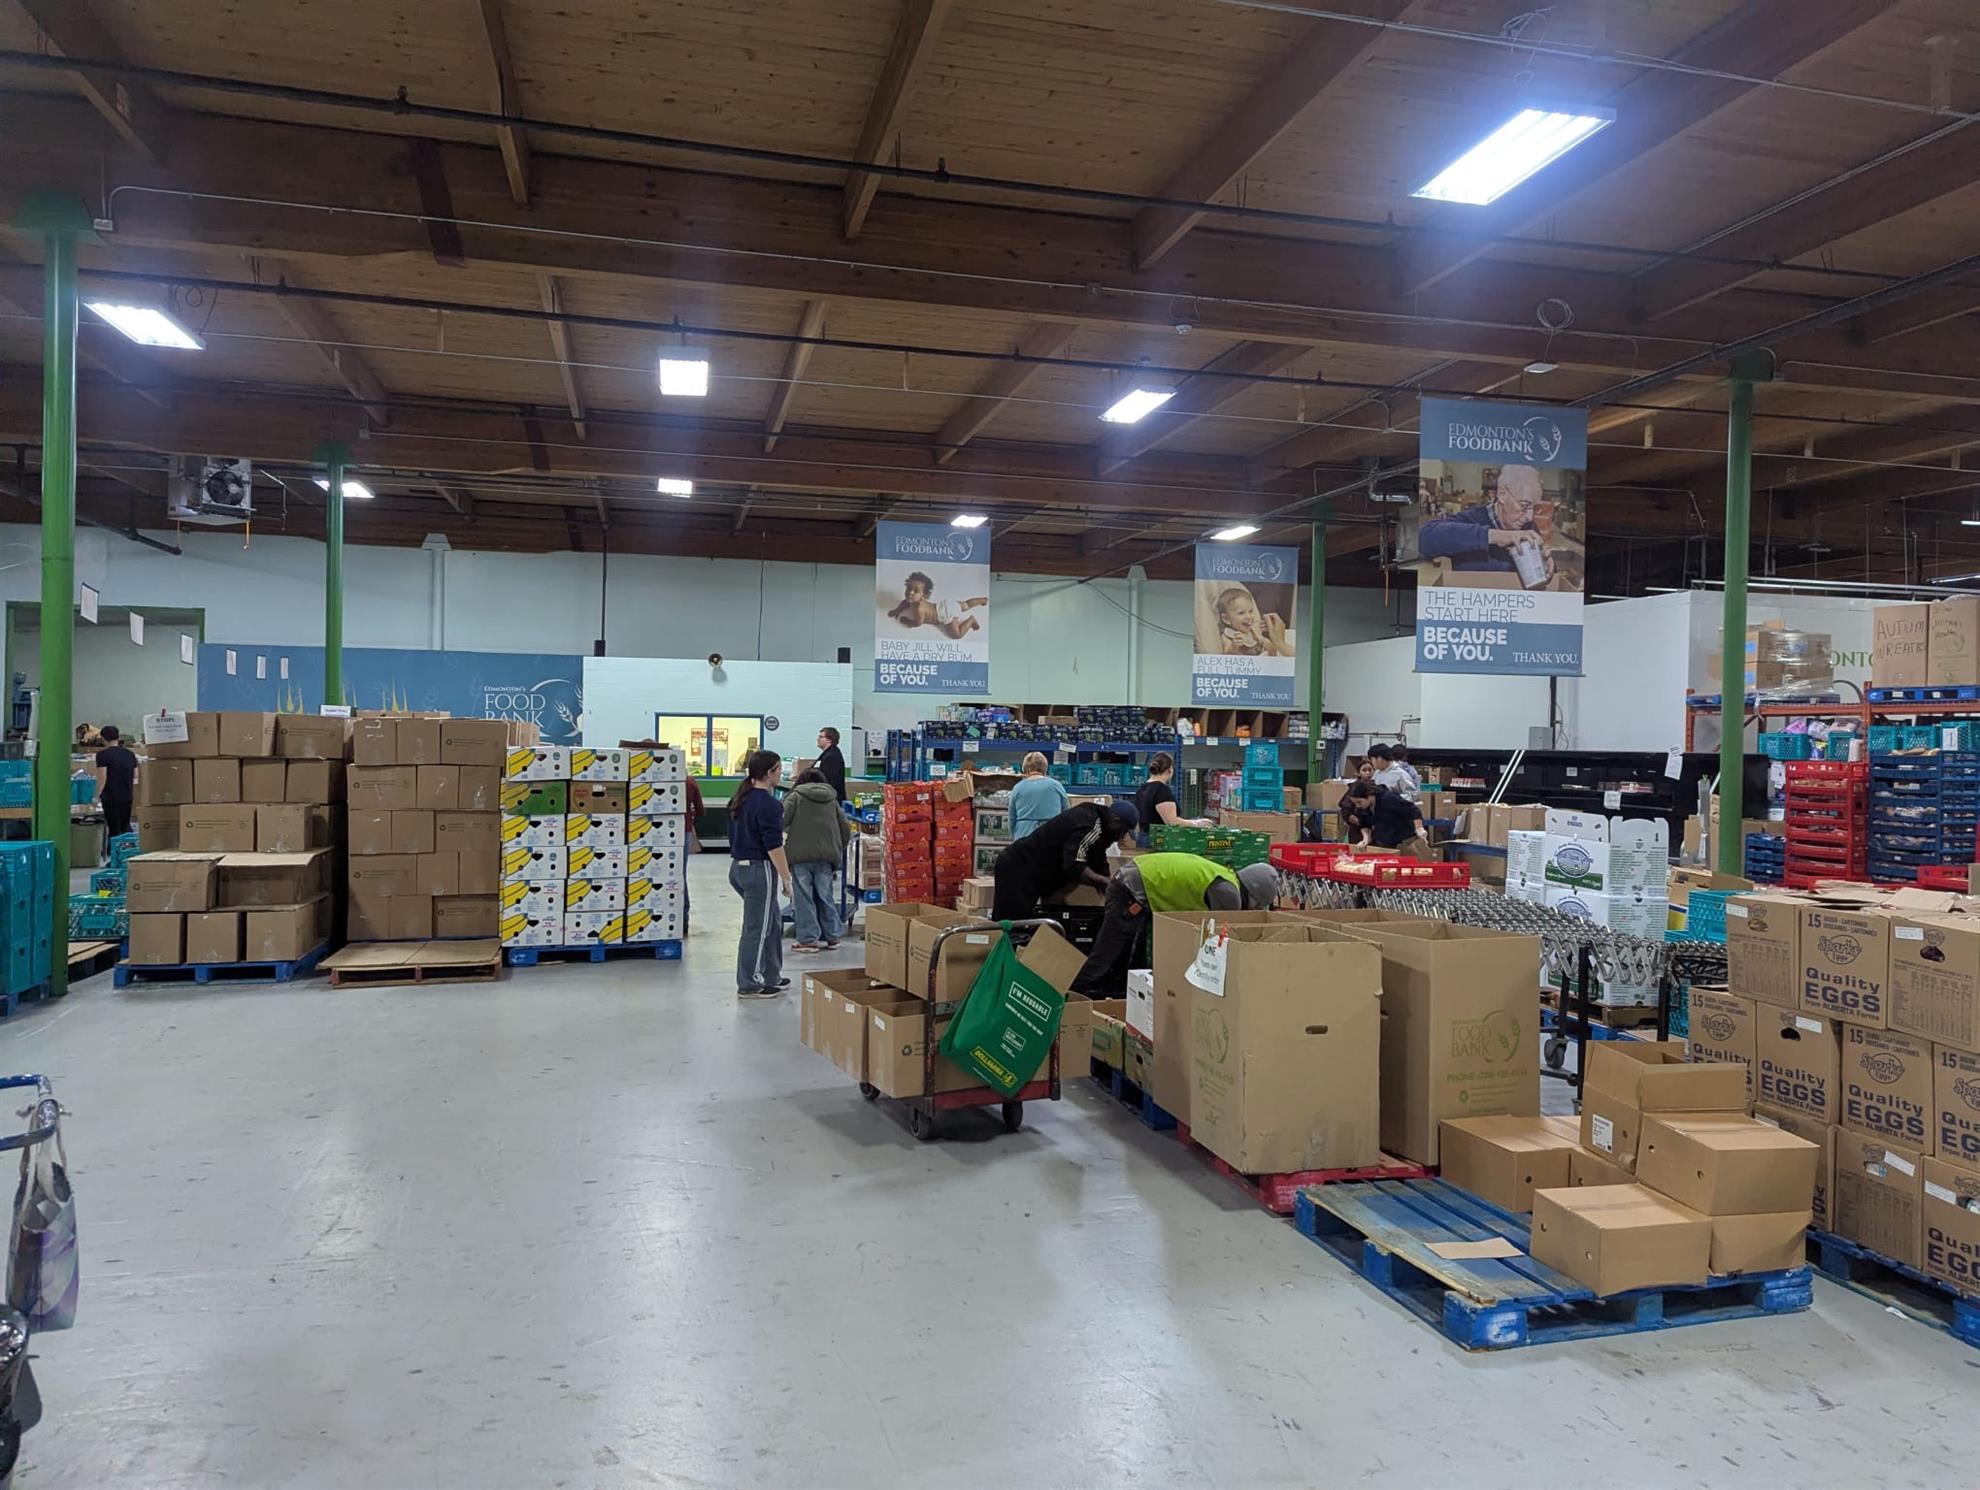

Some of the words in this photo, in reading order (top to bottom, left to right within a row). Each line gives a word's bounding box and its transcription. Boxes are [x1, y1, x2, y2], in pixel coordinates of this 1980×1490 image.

[1449, 423, 1534, 440] EDMONTON'S
[1448, 436, 1533, 454] FOODBANK
[895, 544, 954, 555] FOODBANK
[1212, 565, 1265, 575] FOODBANK
[1425, 590, 1456, 606] THE
[1461, 592, 1535, 608] HAMPERS
[1425, 606, 1472, 621] START
[1478, 608, 1518, 623] HERE
[1423, 626, 1507, 645] BECAUSE
[881, 641, 909, 650] BABY
[913, 642, 932, 651] JILL
[936, 642, 962, 652] WILL
[1423, 644, 1448, 660] OF
[1452, 644, 1494, 662] YOU.
[881, 651, 909, 660] HAVE
[913, 652, 923, 661] A
[925, 652, 944, 661] DRY
[948, 652, 972, 662] BUM
[1197, 656, 1222, 666] ALEX
[1224, 657, 1244, 666] HAS
[1247, 658, 1255, 666] A
[1512, 651, 1553, 664] THANK
[1554, 653, 1579, 665] YOU.
[880, 663, 938, 675] BECAUSE
[1197, 666, 1218, 674] FULL
[1225, 667, 1262, 675] TUMMY
[880, 674, 898, 684] OF
[900, 675, 928, 685] YOU.
[942, 679, 969, 687] THANK
[1196, 677, 1248, 688] BECAUSE
[1196, 687, 1213, 697] OF
[1214, 688, 1240, 698] YOU.
[1251, 692, 1276, 700] THANK
[485, 693, 546, 711] FOOD
[1808, 913, 1821, 928] 15
[1807, 967, 1880, 994] Quality
[1692, 994, 1703, 1007] 15
[1805, 981, 1880, 1013] EGGS
[1823, 1002, 1855, 1016] ALBERTA
[1452, 1024, 1492, 1041] FOOD
[1850, 1028, 1864, 1044] 15
[1451, 1041, 1490, 1057] BANK
[1693, 1043, 1752, 1068] Quality
[1942, 1051, 1957, 1069] 15
[1762, 1060, 1825, 1089] Quality
[1761, 1073, 1826, 1106] EGGS
[1849, 1084, 1924, 1117] Quality
[1848, 1099, 1924, 1136] EGGS
[1865, 1121, 1898, 1138] ALBERTA
